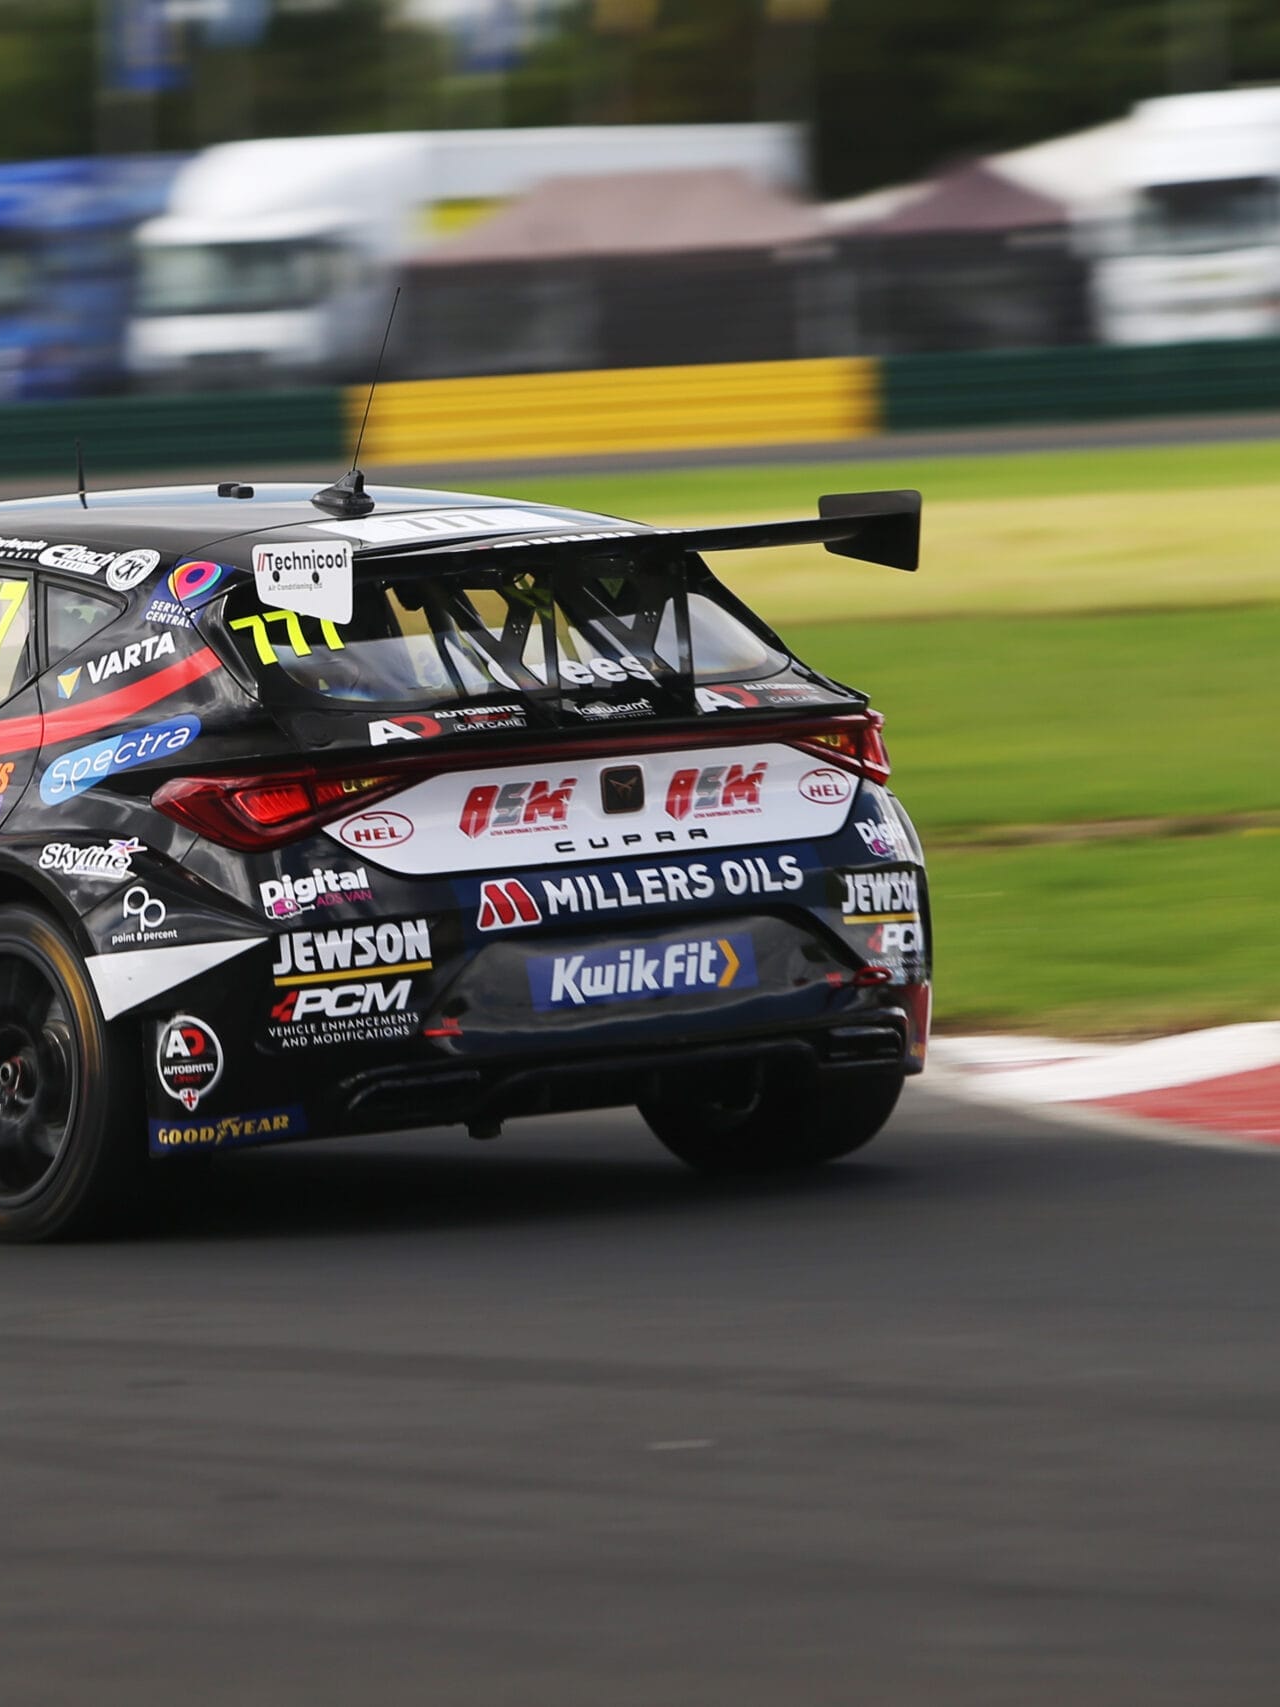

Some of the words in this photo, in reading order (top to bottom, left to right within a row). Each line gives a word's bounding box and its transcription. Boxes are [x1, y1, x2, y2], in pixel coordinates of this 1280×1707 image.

[264, 548, 348, 572] Technicool
[145, 610, 191, 628] CENTRAL
[151, 600, 199, 619] SERVICE
[86, 631, 176, 684] VARTA
[434, 704, 525, 719] AUTOBRITE
[50, 727, 190, 793] Spectra
[809, 784, 844, 798] HEL
[354, 825, 403, 842] HEL
[555, 828, 709, 853] CUPRA
[40, 843, 131, 872] Skyline
[259, 867, 370, 907] Digital
[541, 863, 716, 915] MILLERS
[720, 855, 805, 896] OILS
[315, 893, 345, 907] ADS
[112, 931, 136, 945] point
[143, 929, 178, 942] percent
[272, 919, 432, 975] JEWSON
[292, 979, 412, 1021] PCM
[268, 1023, 317, 1038] VEHICLE
[321, 1012, 420, 1034] ENHANCEMENTS
[281, 1036, 308, 1048] AND
[313, 1025, 410, 1044] MODIFICATIONS
[163, 1063, 214, 1075] AUTOBRITE
[158, 1115, 290, 1144] GOODYEAR
